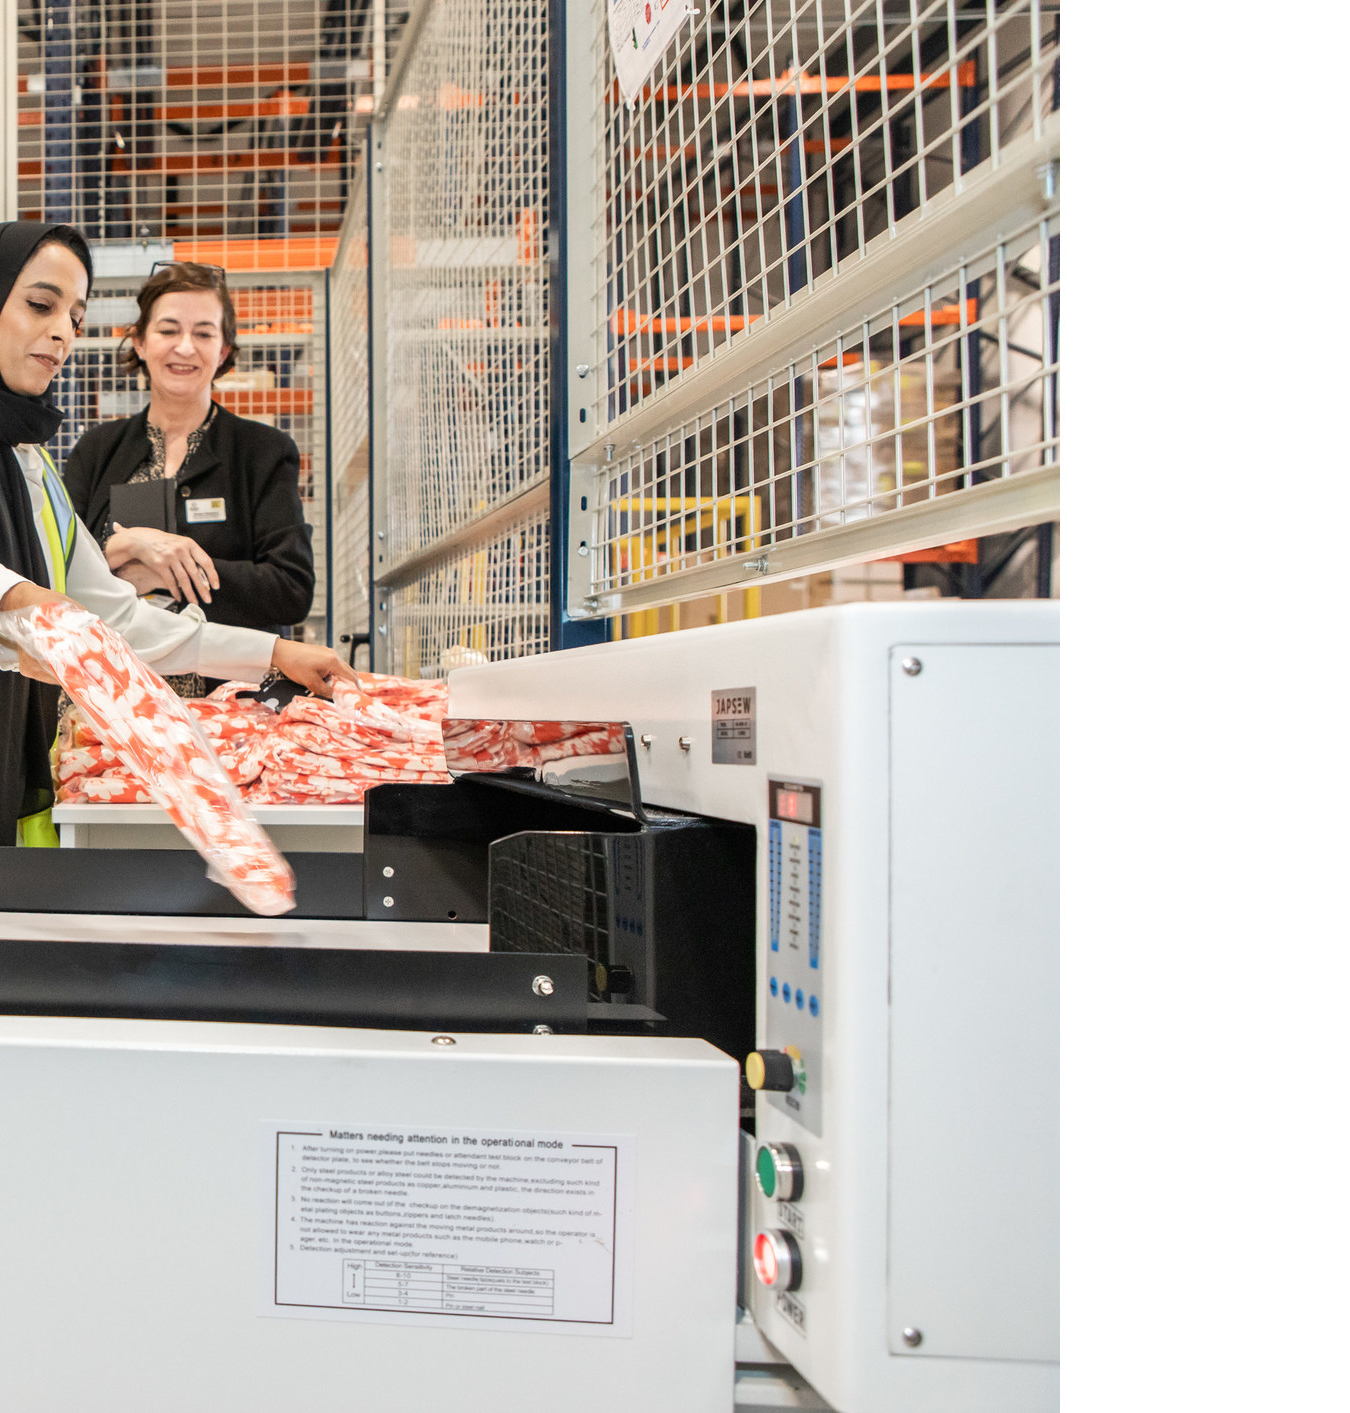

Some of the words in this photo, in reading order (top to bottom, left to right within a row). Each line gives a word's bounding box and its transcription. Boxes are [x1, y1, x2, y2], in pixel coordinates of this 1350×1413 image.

[716, 697, 751, 714] JAPSEW
[329, 1130, 363, 1140] Matters
[367, 1132, 403, 1144] needing
[407, 1134, 447, 1144] attention
[451, 1136, 460, 1144] in
[462, 1136, 477, 1145] the
[480, 1137, 534, 1148] operational
[537, 1140, 563, 1149] mode
